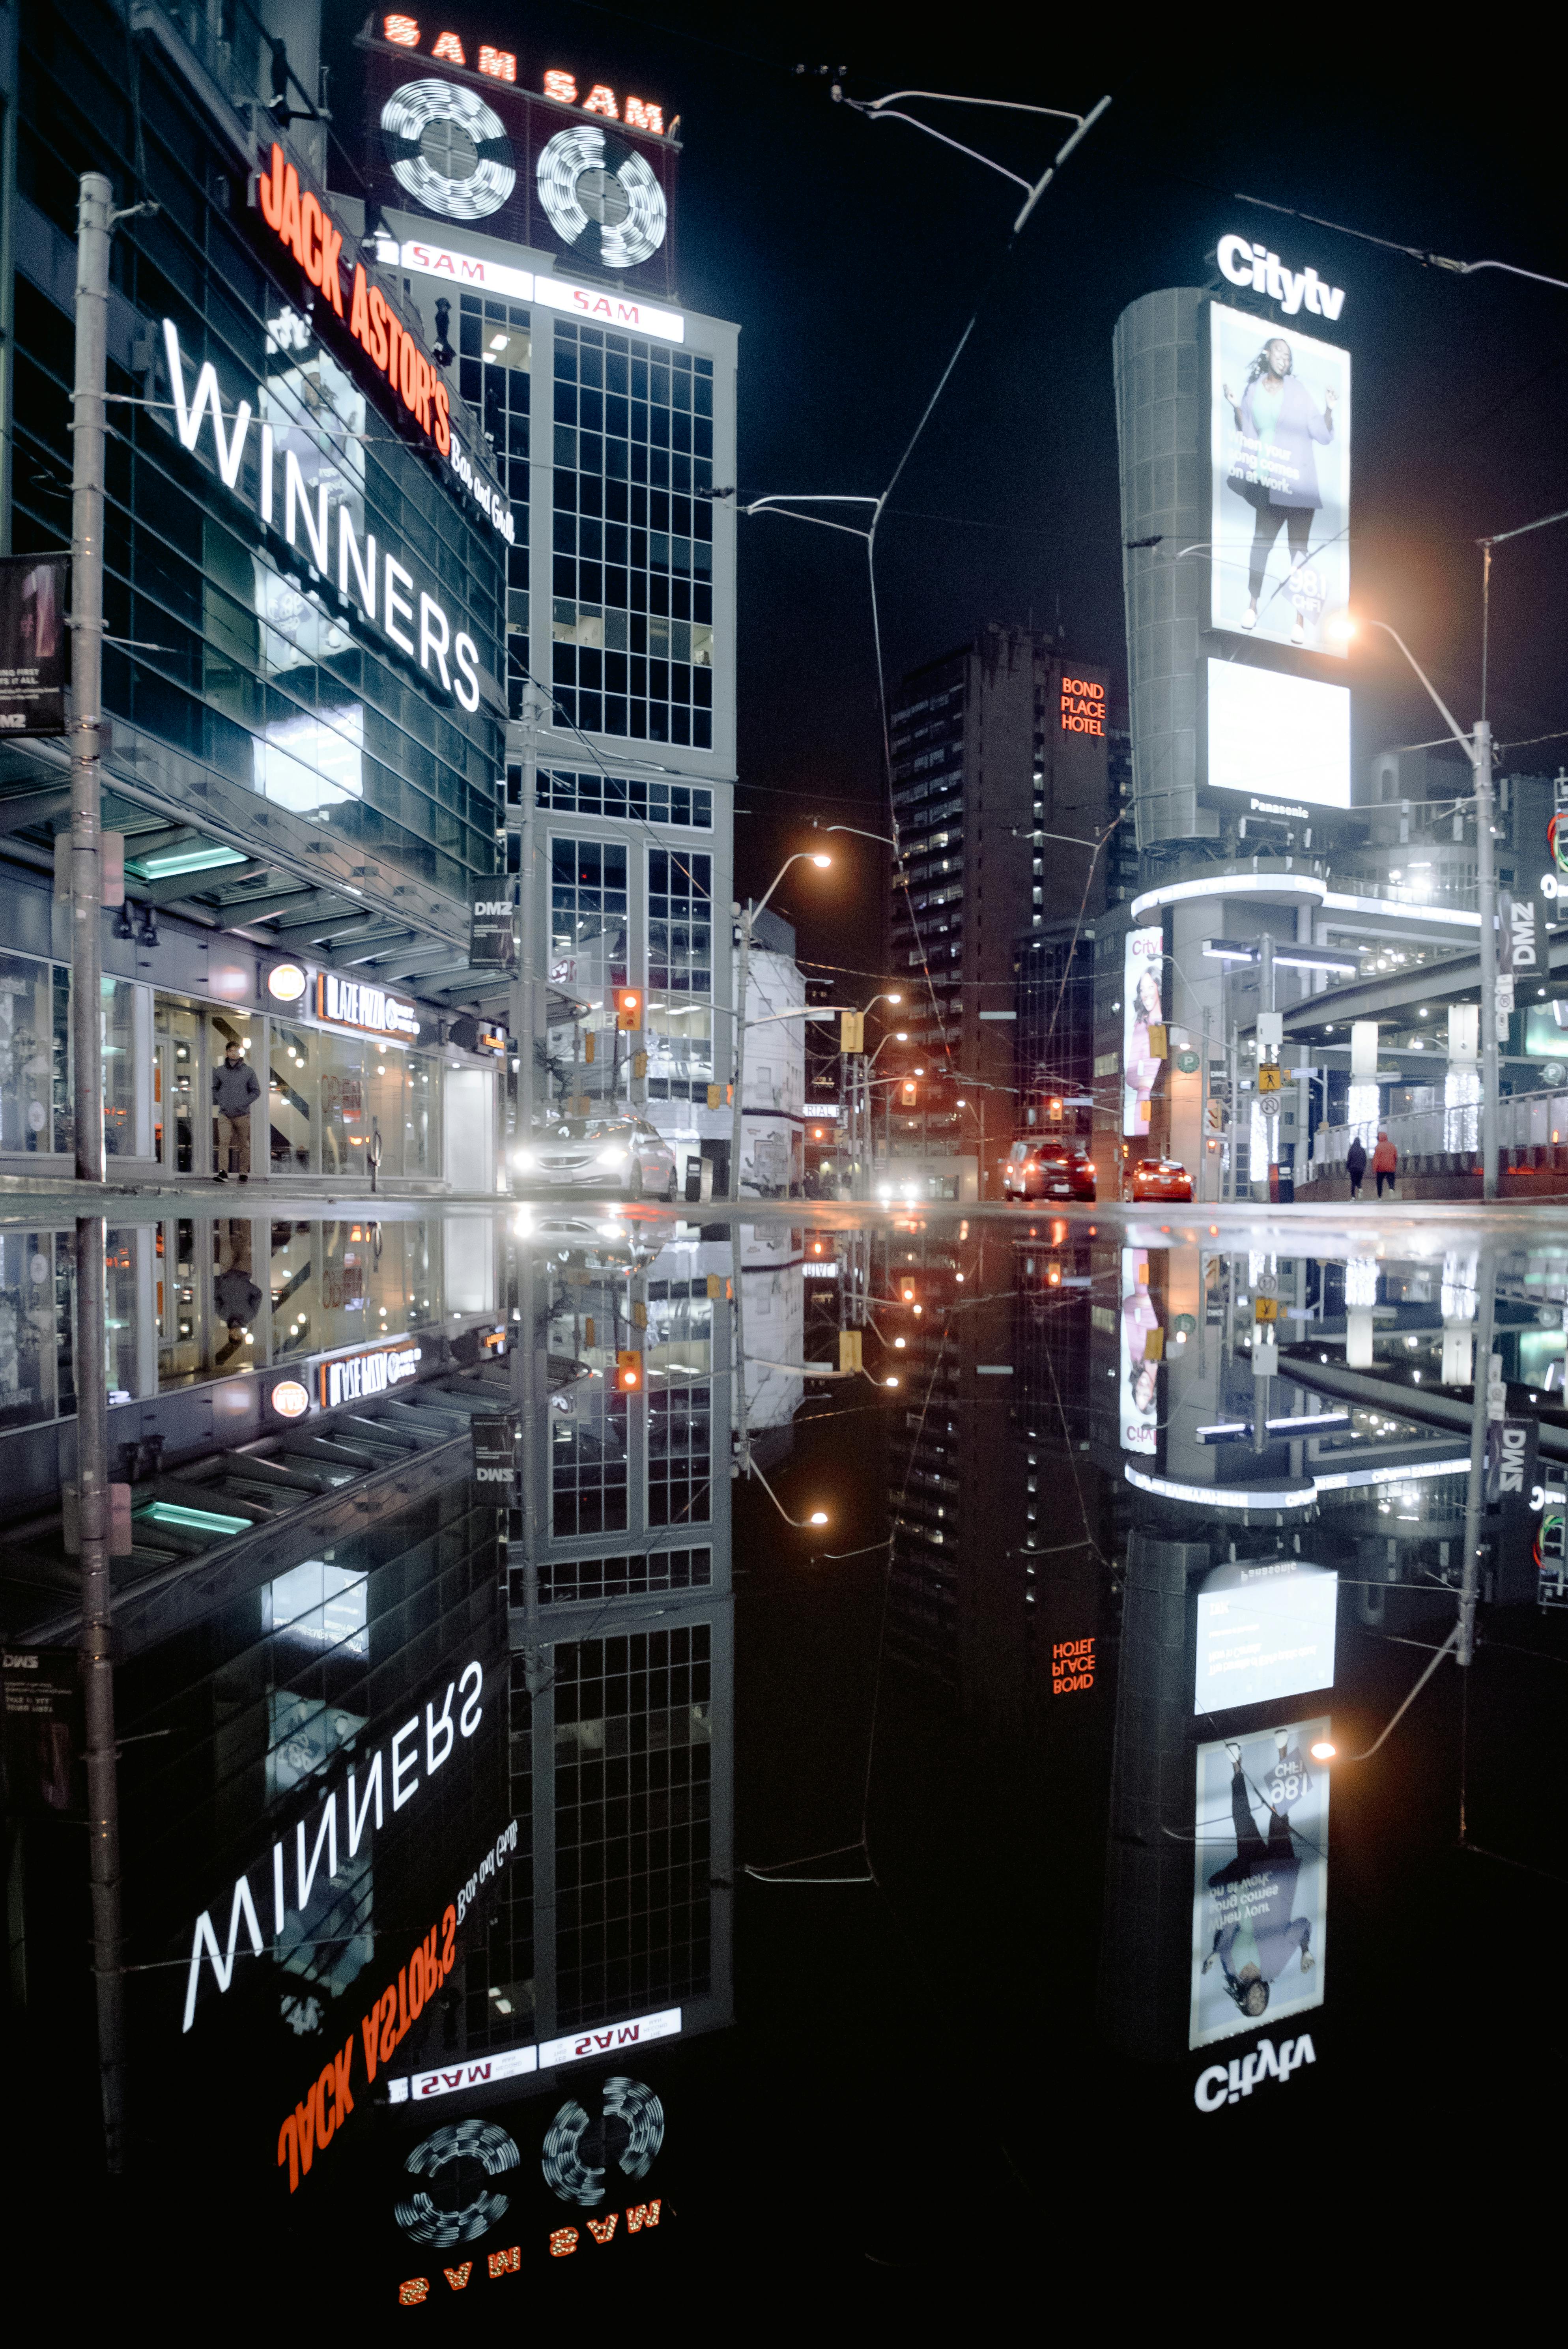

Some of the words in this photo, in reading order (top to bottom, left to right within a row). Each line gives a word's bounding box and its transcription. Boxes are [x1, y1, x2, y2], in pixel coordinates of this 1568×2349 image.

[384, 14, 516, 82] SAM
[543, 69, 664, 135] SAM
[413, 247, 486, 281] SAM
[1216, 234, 1345, 321] Citytv
[259, 142, 344, 318] JACK
[349, 261, 450, 456] ASTOR'S
[573, 290, 639, 324] SAM
[1264, 444, 1292, 462] your
[450, 432, 473, 490] Bar
[474, 477, 491, 515] and
[1229, 466, 1243, 480] on
[1245, 469, 1258, 484] at
[1260, 477, 1293, 494] work.
[1260, 458, 1300, 480] comes
[163, 318, 480, 712] WINNERS
[1292, 593, 1322, 613] CHFI
[1063, 677, 1104, 699] BOND
[1061, 696, 1106, 719] PLACE
[0, 714, 26, 728] MZ
[1062, 714, 1105, 736] HOTEL
[1250, 798, 1309, 819] Panasonic
[475, 901, 513, 916] DMZ
[1510, 902, 1536, 965] DMZ
[1132, 937, 1159, 956] City
[1185, 1056, 1194, 1065] P
[803, 1105, 831, 1117] RIAL
